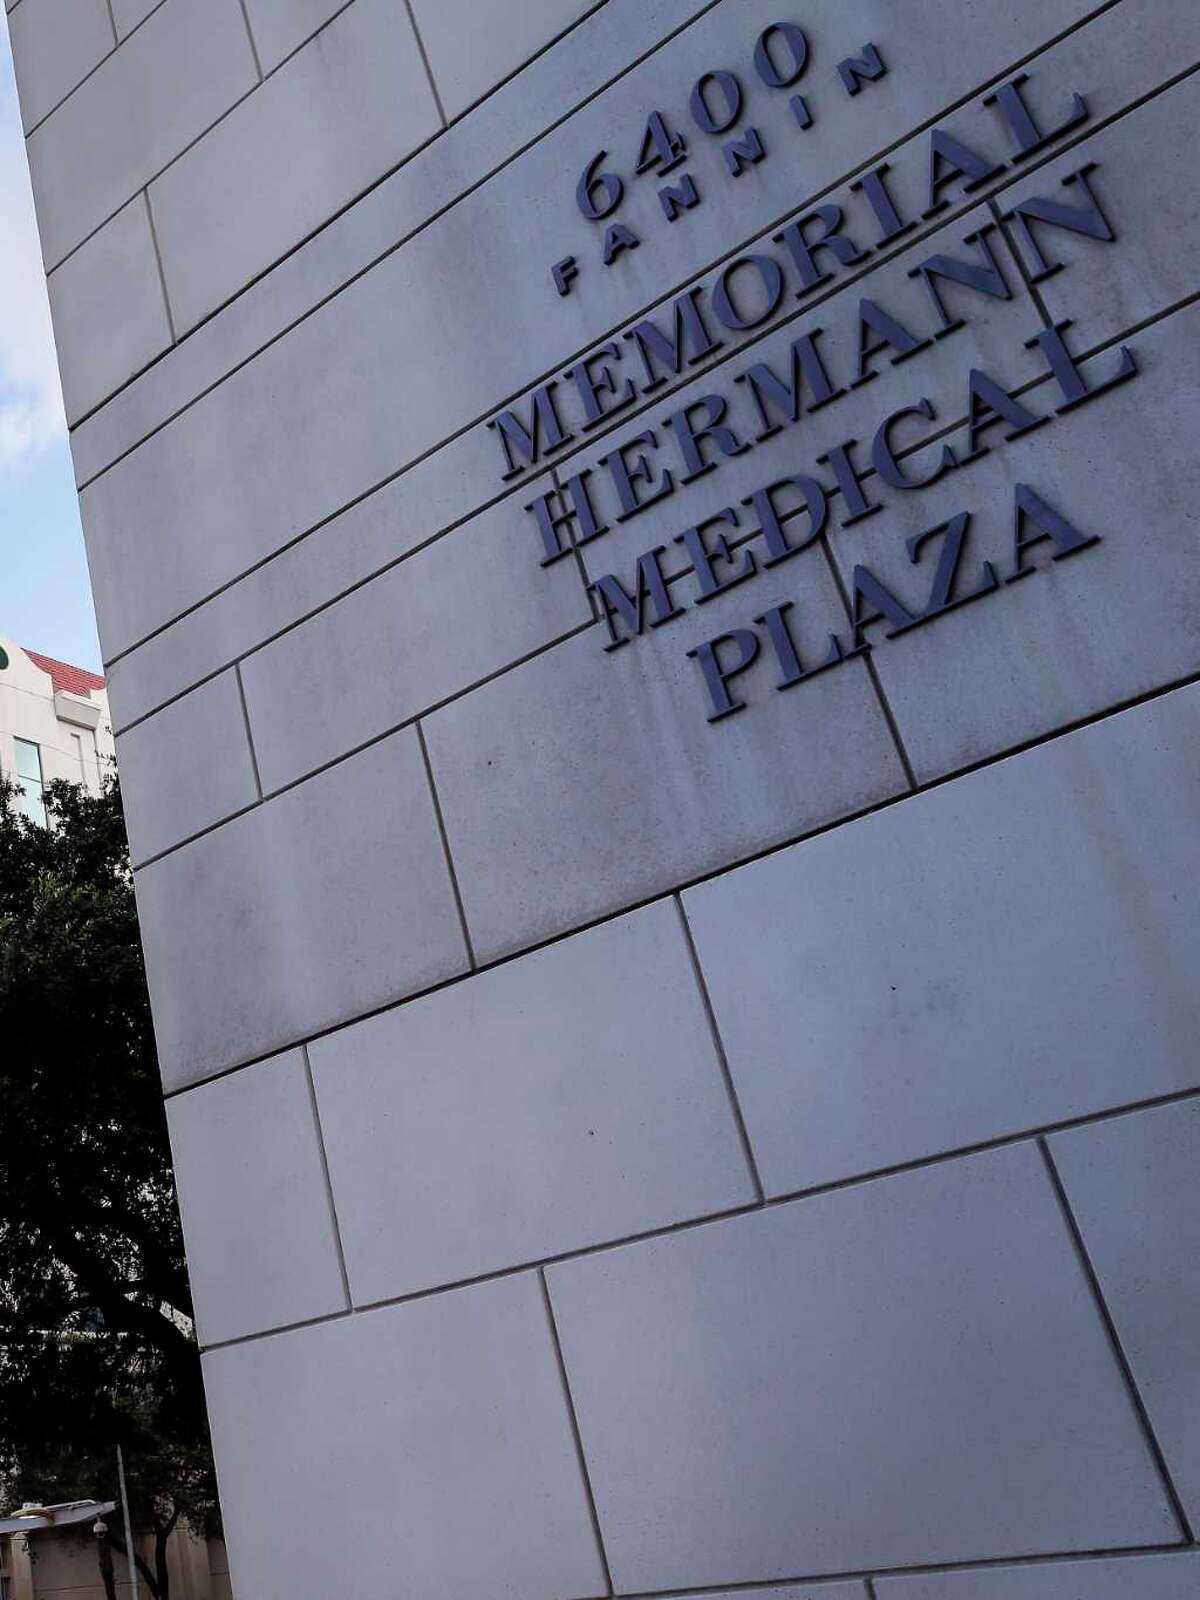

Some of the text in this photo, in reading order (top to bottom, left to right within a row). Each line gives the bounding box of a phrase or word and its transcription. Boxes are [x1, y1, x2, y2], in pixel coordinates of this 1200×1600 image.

[550, 42, 888, 297] FANNIN
[575, 21, 810, 221] 6400
[485, 72, 1093, 482] MEMORIAL
[523, 162, 1118, 569] HERMANN
[586, 318, 1141, 653] MEDICAL
[686, 482, 1102, 724] PLAZA
